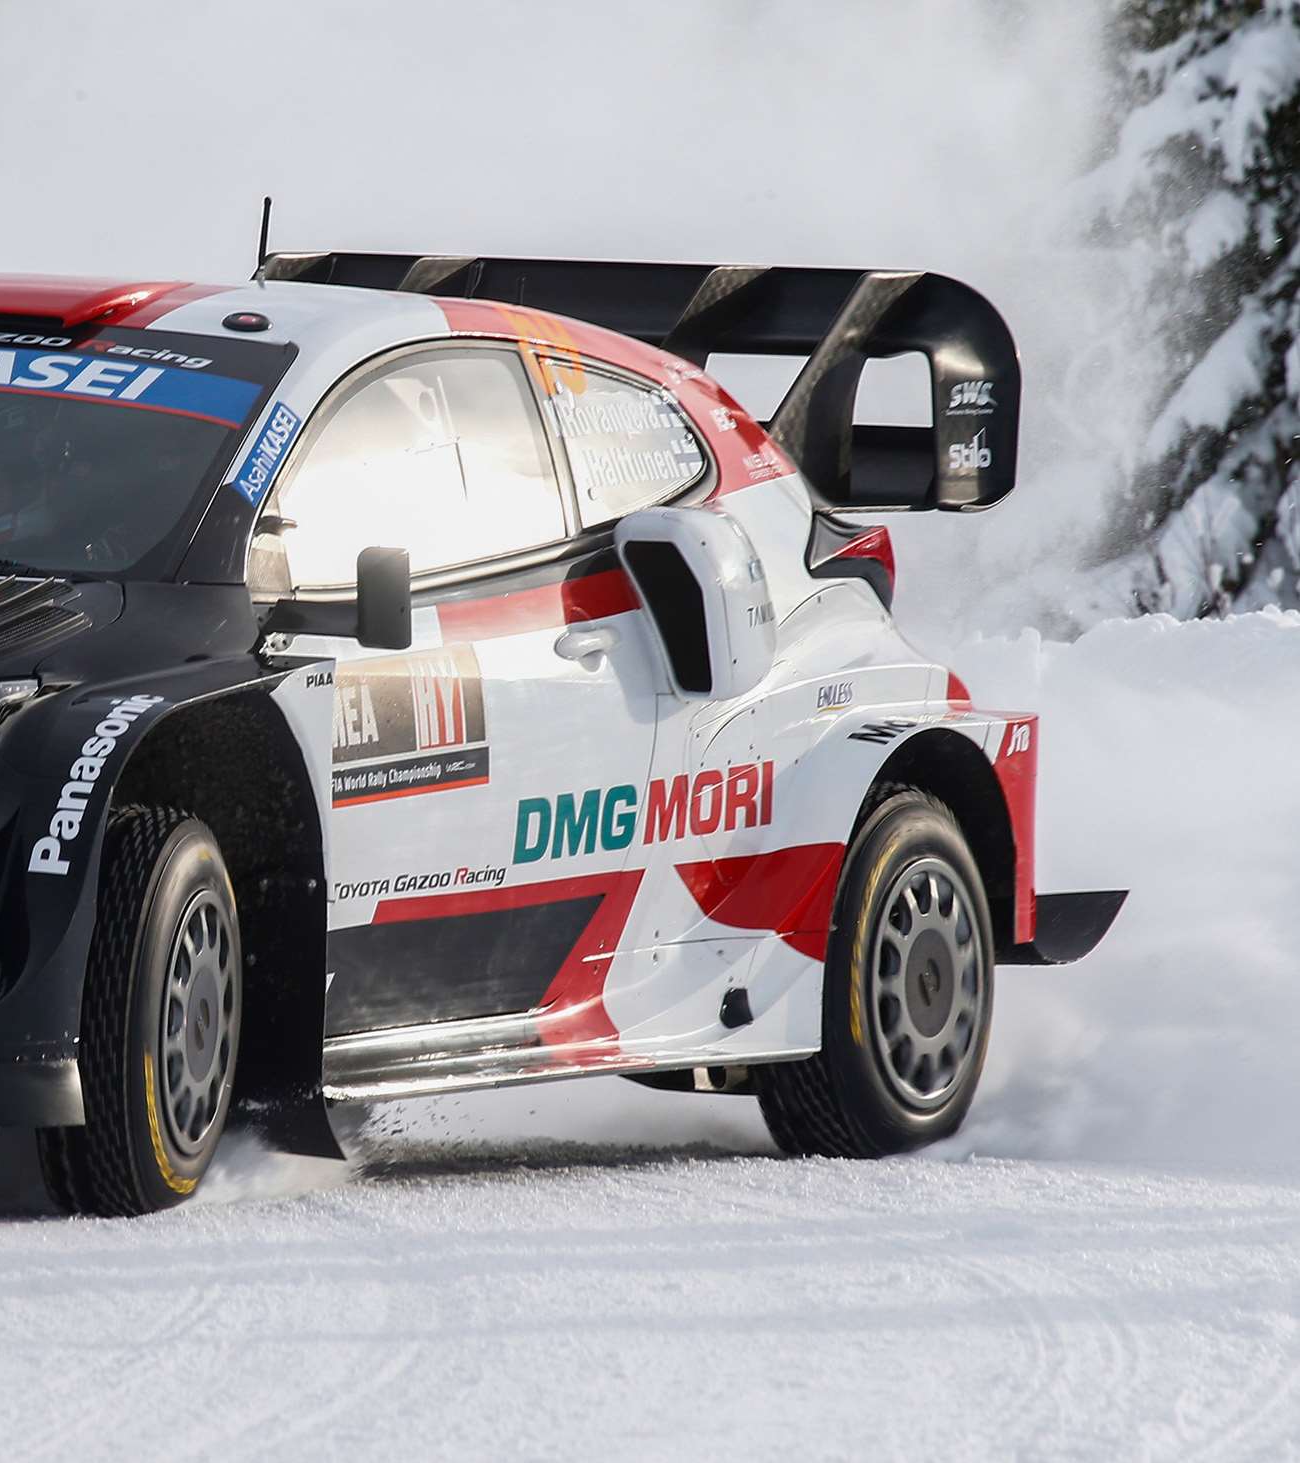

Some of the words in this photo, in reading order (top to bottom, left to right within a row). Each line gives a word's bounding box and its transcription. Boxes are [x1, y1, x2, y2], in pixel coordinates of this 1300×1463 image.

[75, 339, 213, 369] Racing
[305, 672, 334, 689] PIAA
[28, 694, 165, 875] Panasonic
[344, 772, 368, 791] World
[367, 770, 388, 789] Rally
[388, 762, 442, 784] Championship
[512, 784, 638, 865] DMG
[643, 760, 774, 845] MORI
[393, 872, 451, 892] GAZOO
[453, 864, 507, 887] Racing
